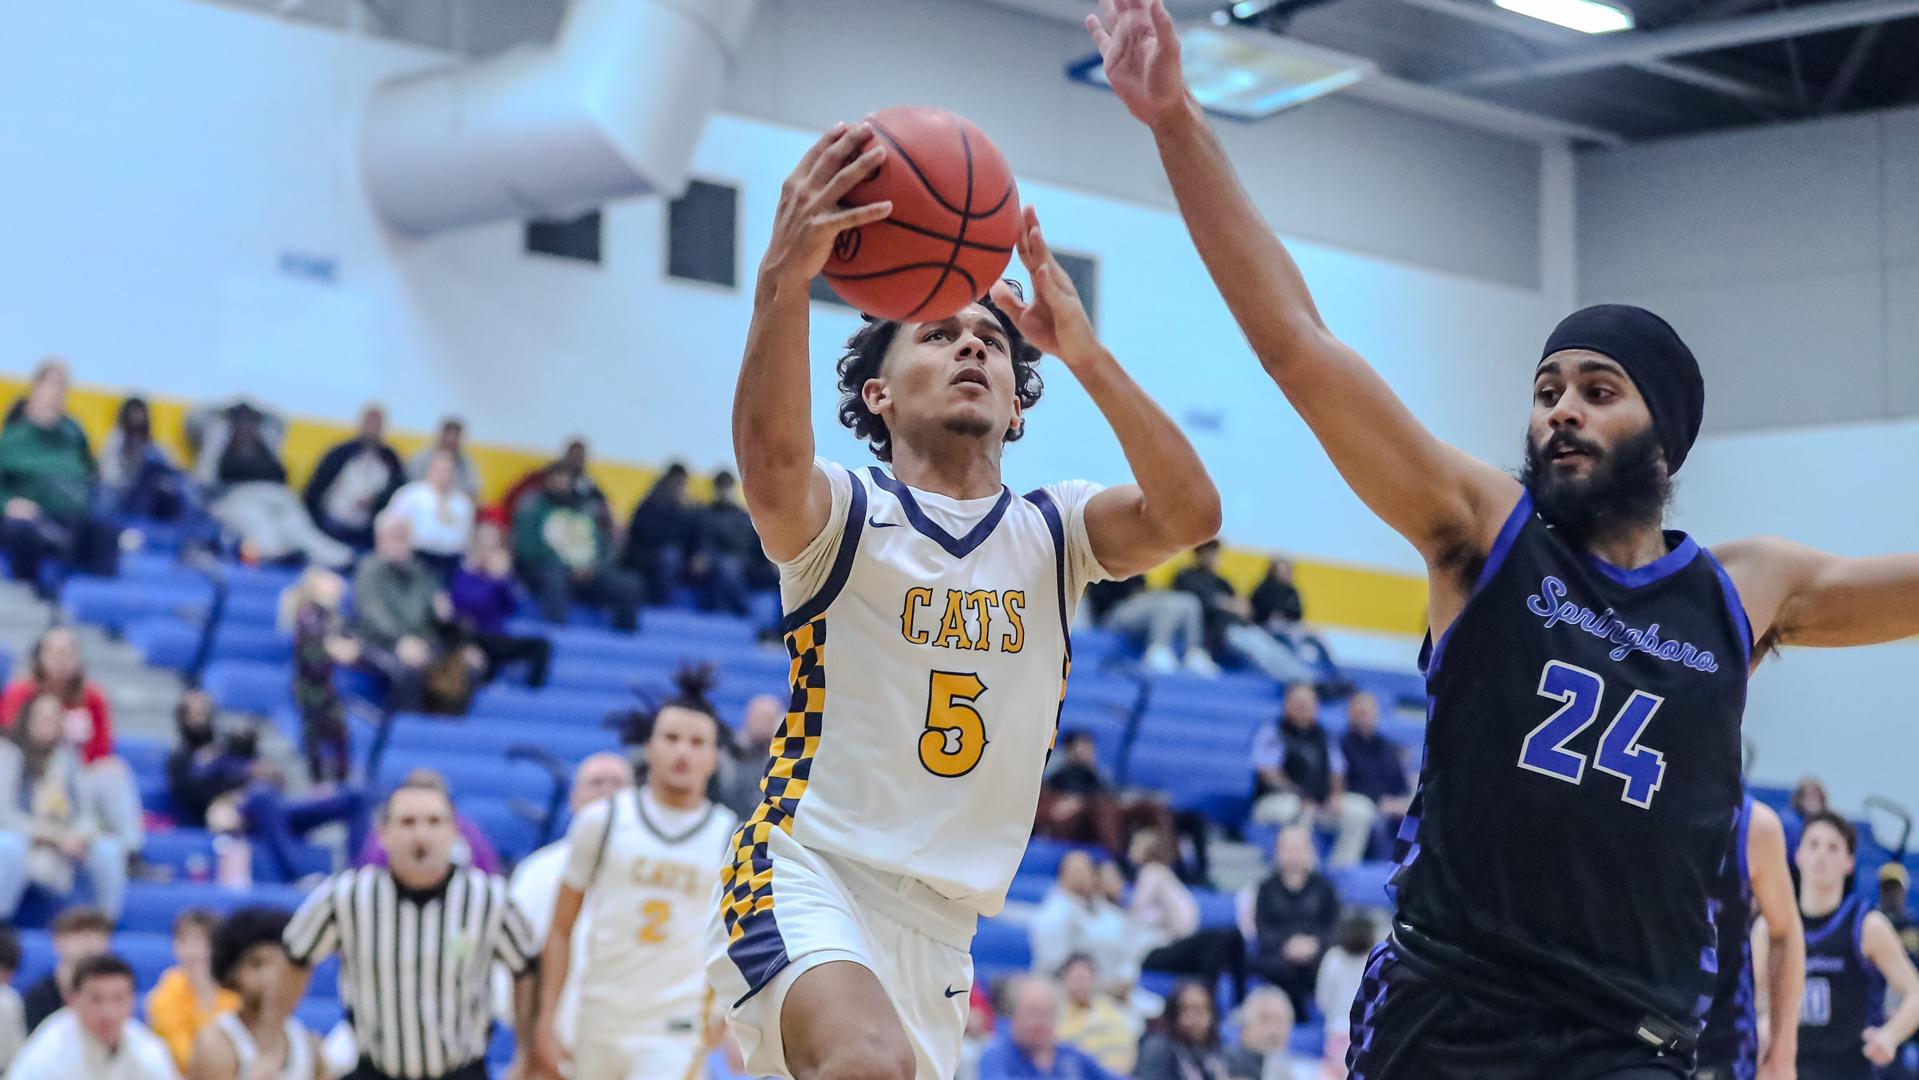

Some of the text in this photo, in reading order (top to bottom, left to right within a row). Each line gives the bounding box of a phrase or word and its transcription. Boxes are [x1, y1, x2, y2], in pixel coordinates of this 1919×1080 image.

[900, 587, 1026, 654] CATS
[1526, 575, 1719, 673] Springboro
[917, 669, 990, 778] 5
[1517, 659, 1667, 810] 24
[636, 899, 671, 943] 2
